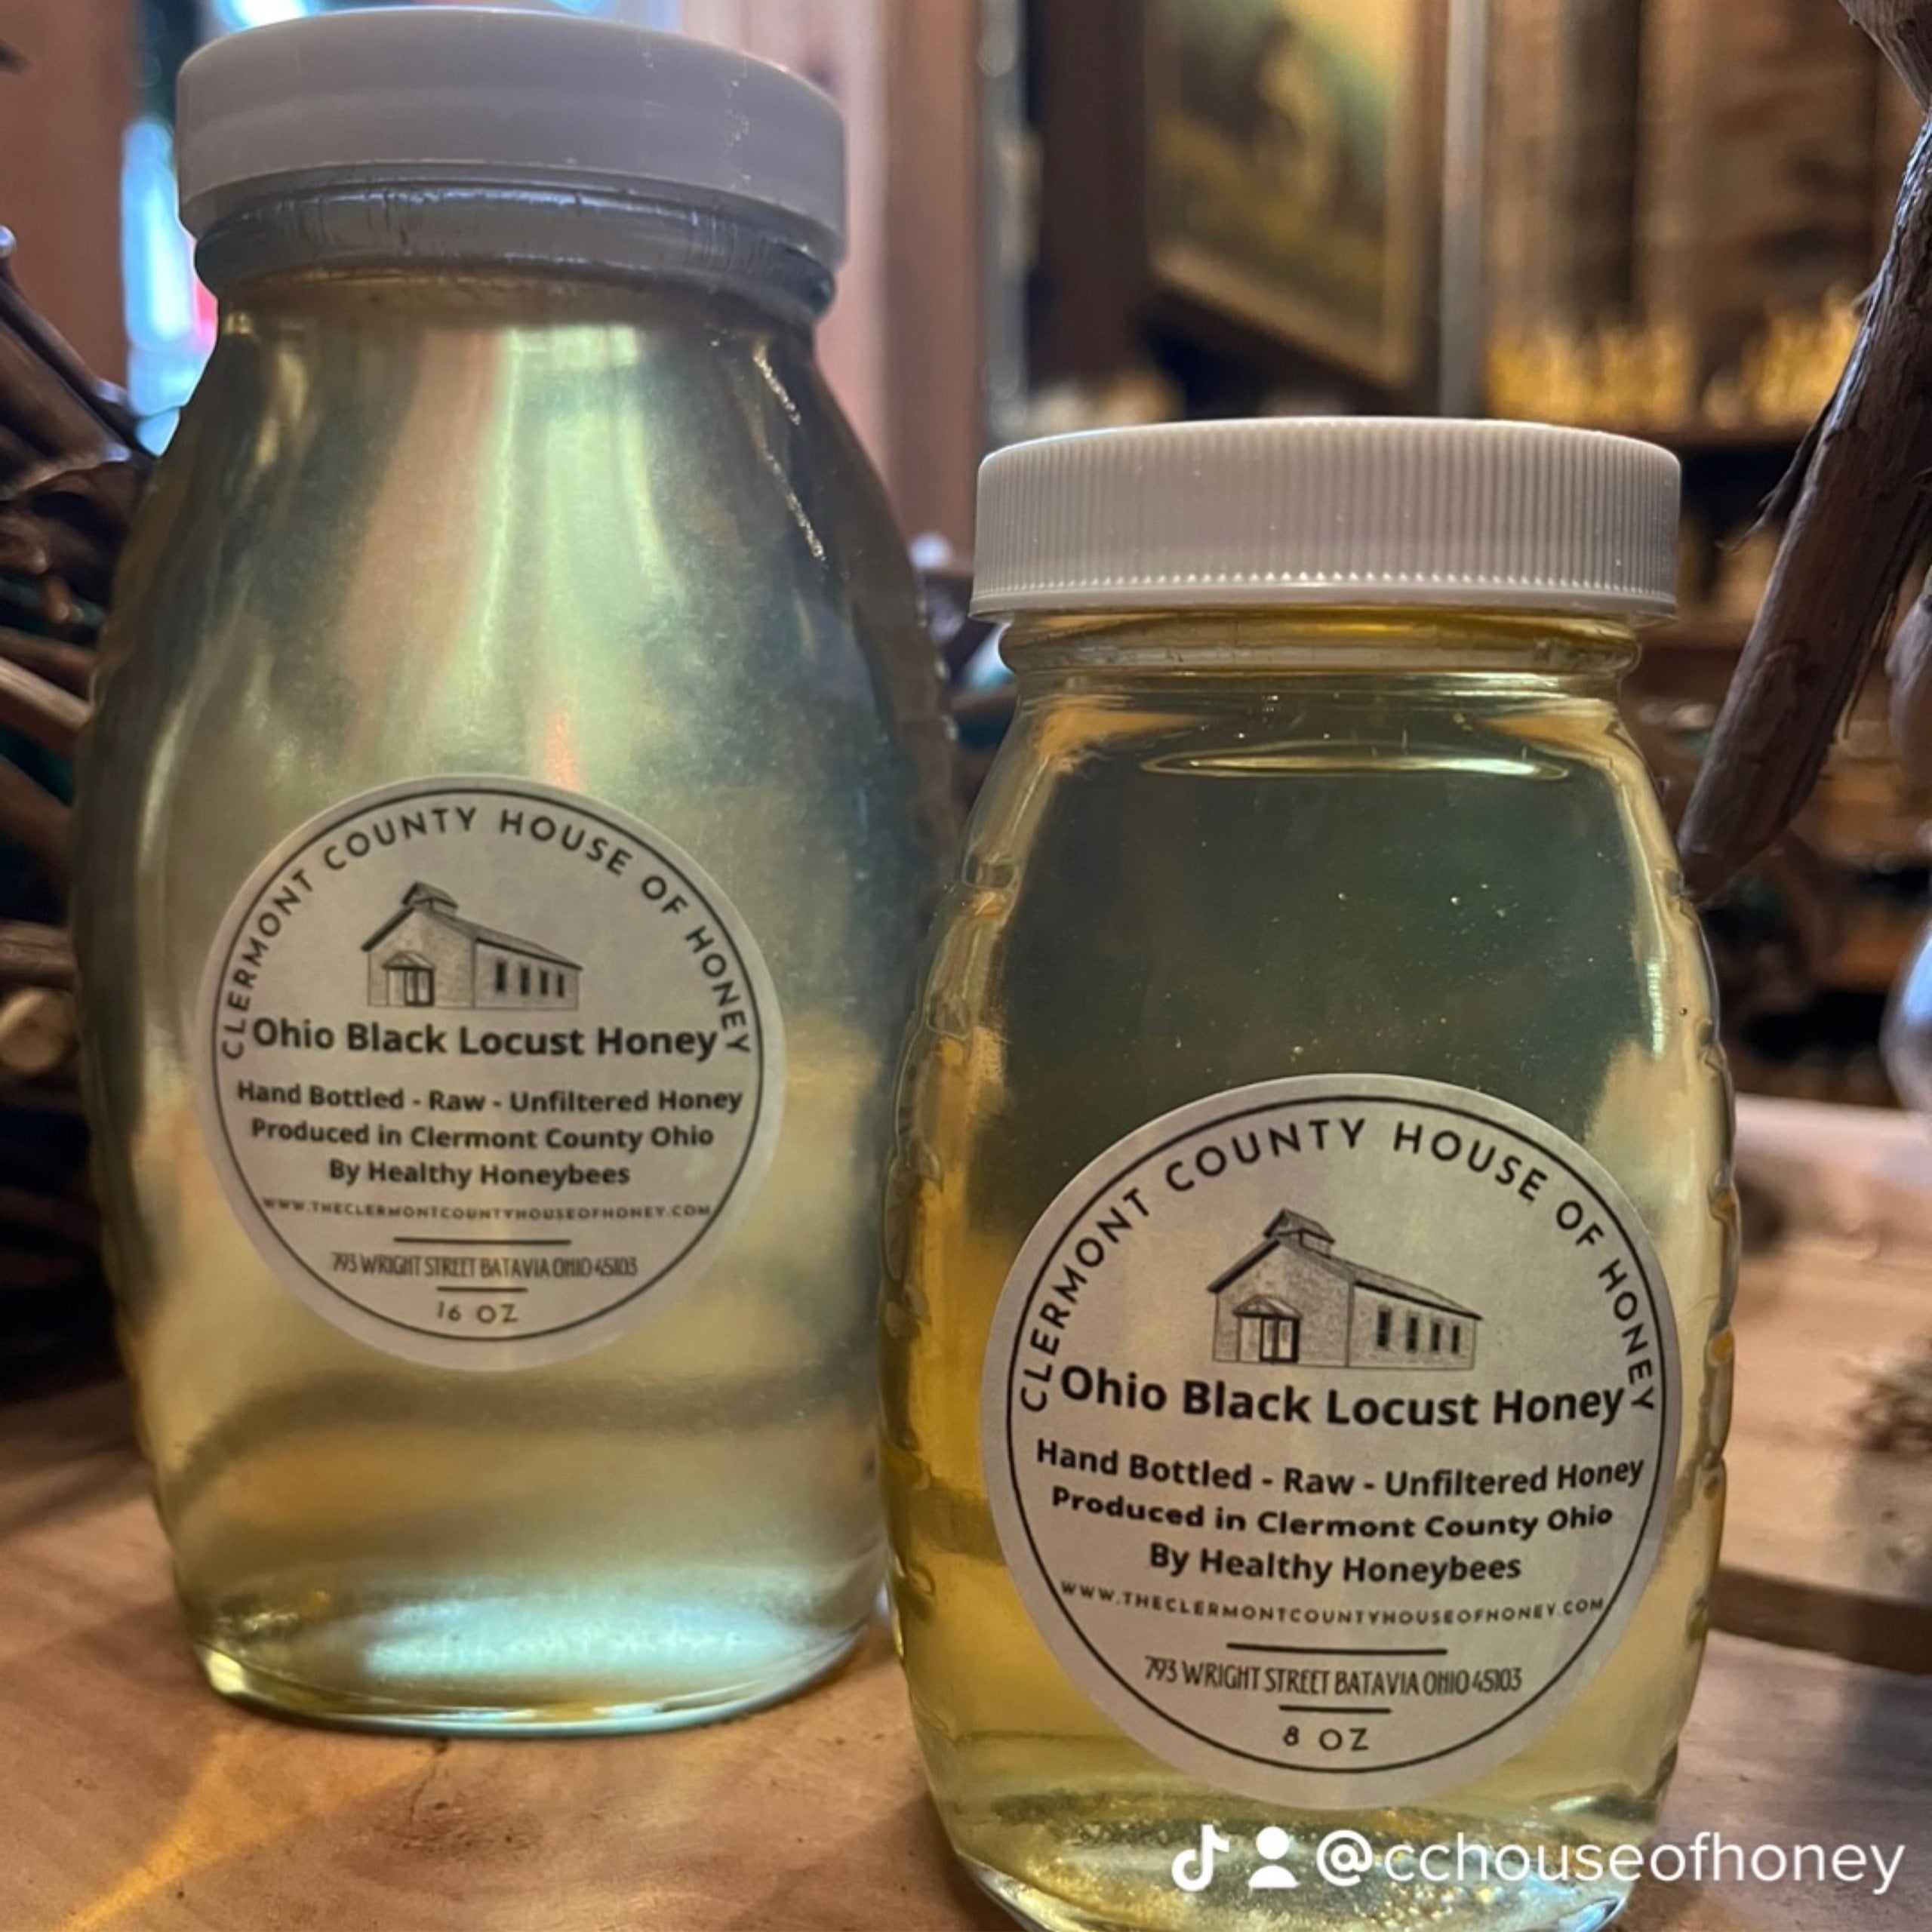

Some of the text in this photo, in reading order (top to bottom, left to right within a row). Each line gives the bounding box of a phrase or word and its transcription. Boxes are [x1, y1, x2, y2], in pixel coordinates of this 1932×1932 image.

[221, 807, 752, 1060] CLERMONT COUNTY HOUSE OF HONEY
[253, 1018, 718, 1062] Ohio Black Locust Honey
[237, 1081, 301, 1105] Hand
[309, 1084, 404, 1109] Bottled
[429, 1091, 486, 1112] Raw
[510, 1091, 648, 1113] Unfiltered
[658, 1089, 743, 1115] Honey
[252, 1119, 714, 1152] Produced in Clermont County Ohio
[329, 1160, 630, 1187] By Healthy Honeybees
[331, 1253, 638, 1278] 793 WRIGHT STREET BATAVIA OHIO 45103
[1020, 1118, 1654, 1412] CLERMONT COUNTY HOUSE OF HONEY
[436, 1301, 518, 1324] 16 OZ
[1060, 1367, 1624, 1427] Ohio Black Locust Honey
[1036, 1438, 1118, 1476] Hand
[1129, 1454, 1253, 1491] Bottled
[1284, 1467, 1354, 1494] Raw
[1385, 1468, 1547, 1497] Unfiltered
[1557, 1458, 1643, 1492] Honey
[1052, 1486, 1612, 1540] Produced in Clermont County Ohio
[1150, 1543, 1521, 1588] By Healthy Honeybees
[1145, 1655, 1522, 1696] 793 WRIGHT STREET BATAVIA OHIO 45103
[1283, 1725, 1369, 1751] 8 OZ
